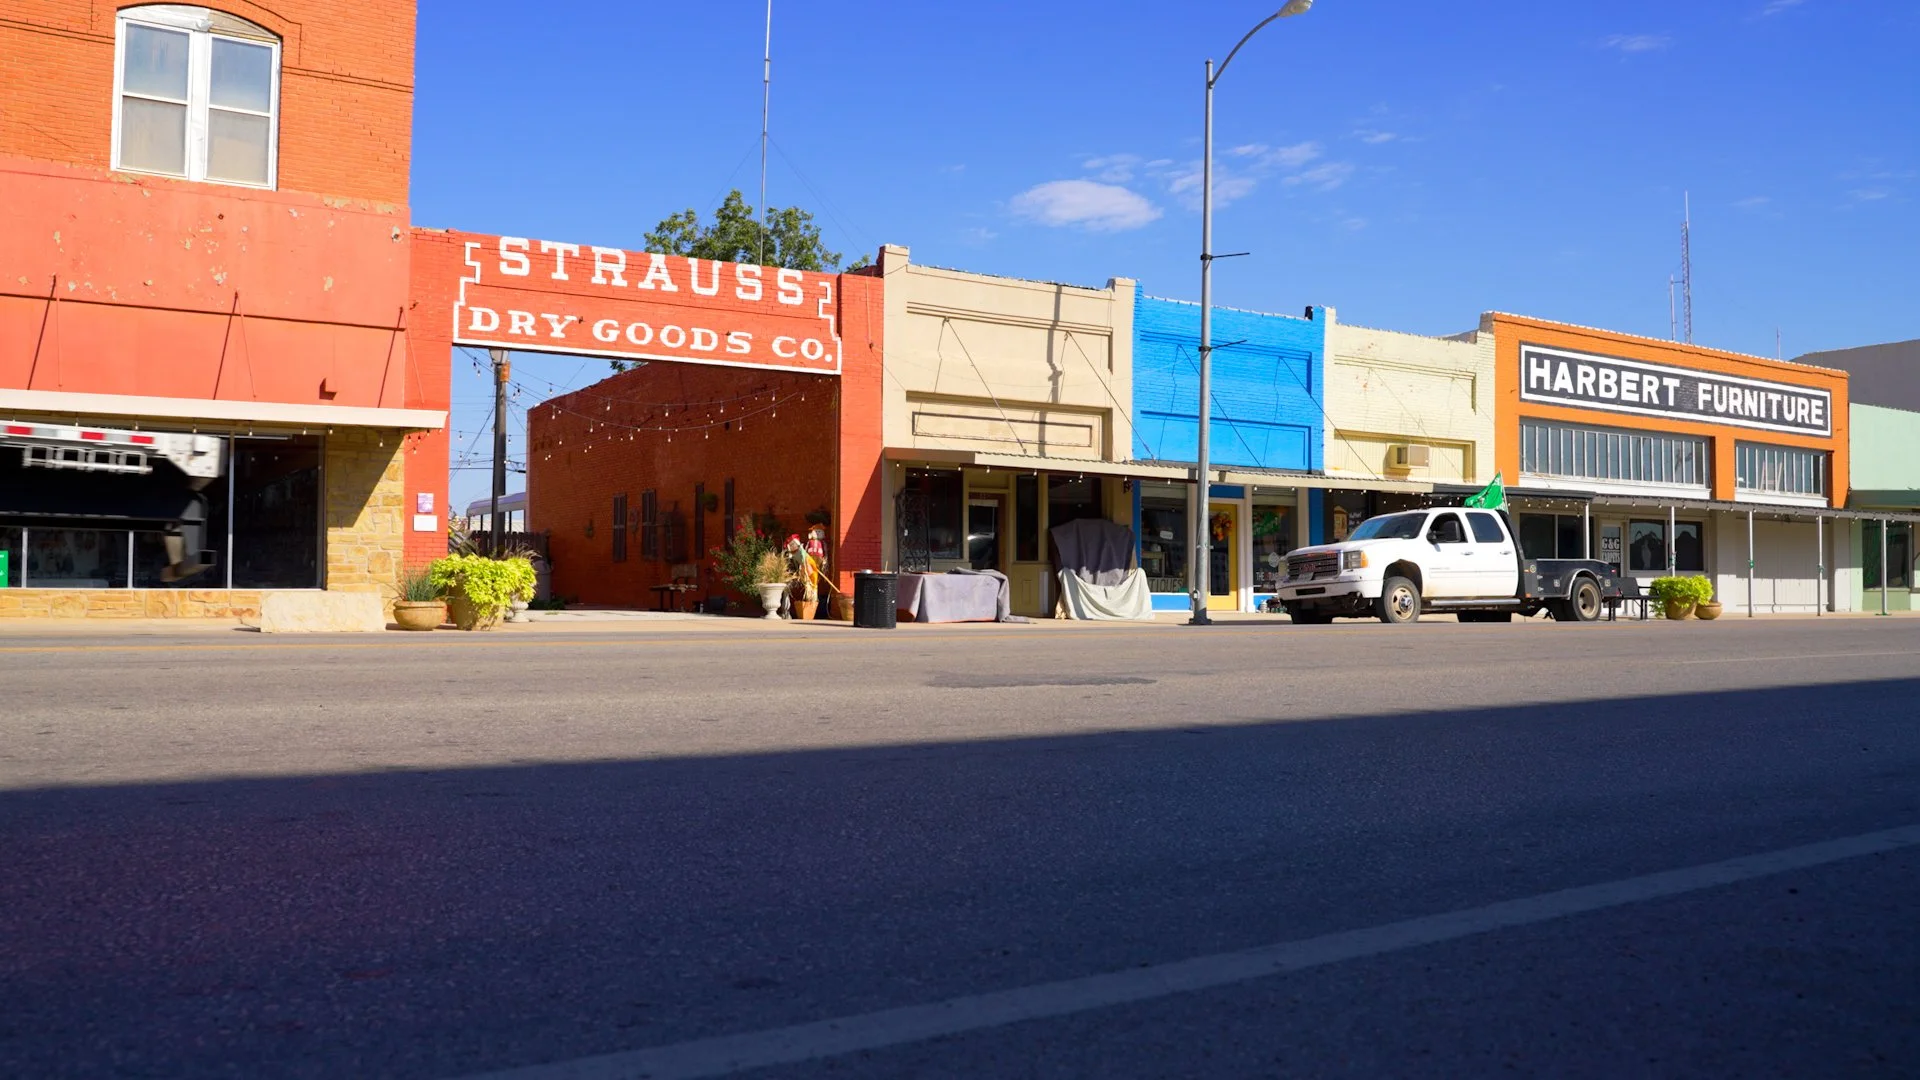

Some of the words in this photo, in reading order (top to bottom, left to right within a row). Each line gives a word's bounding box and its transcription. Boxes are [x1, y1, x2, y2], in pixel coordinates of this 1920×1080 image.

[500, 236, 804, 305] STRAUSS
[468, 306, 578, 338] DRY
[592, 319, 753, 354] GOODS
[771, 336, 833, 362] CO.
[1530, 357, 1681, 406] HARBERT
[1698, 382, 1824, 426] FURNITURE
[1602, 537, 1620, 550] G&G
